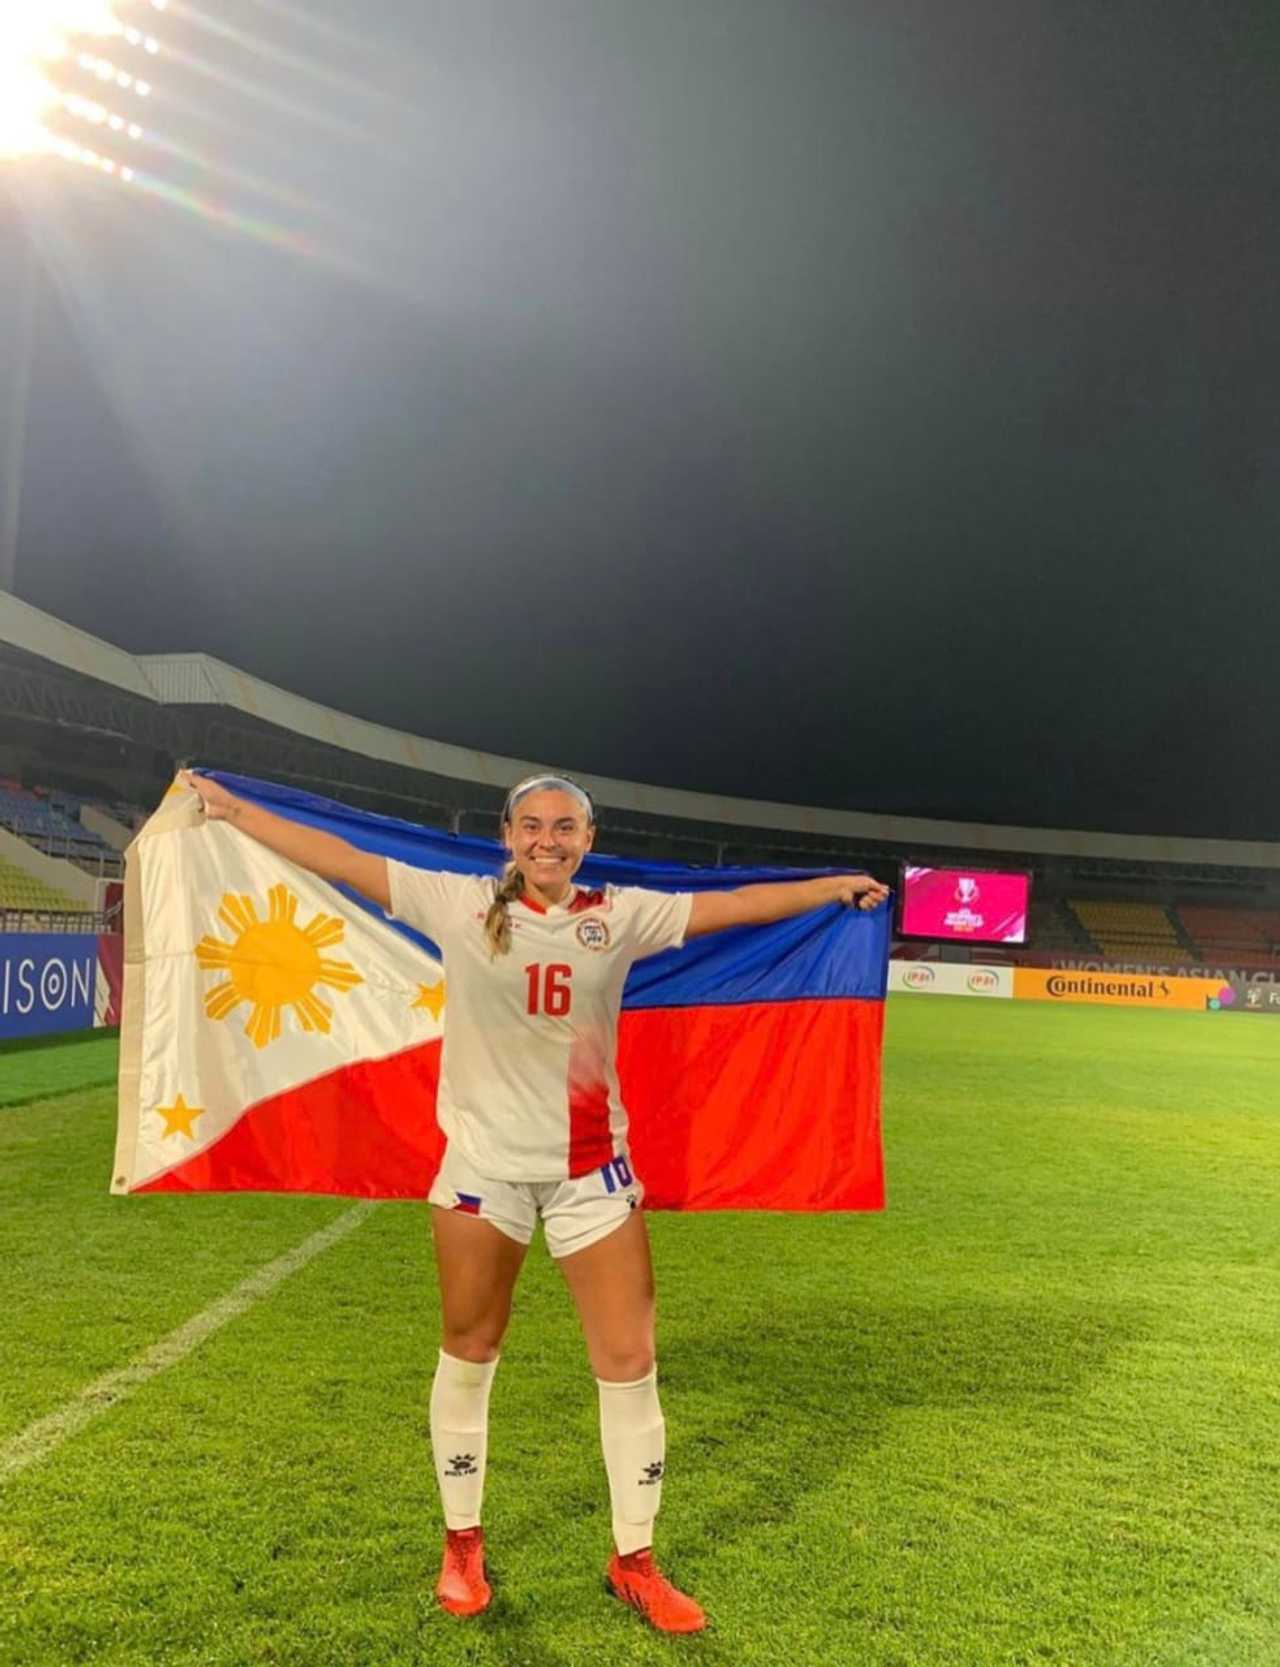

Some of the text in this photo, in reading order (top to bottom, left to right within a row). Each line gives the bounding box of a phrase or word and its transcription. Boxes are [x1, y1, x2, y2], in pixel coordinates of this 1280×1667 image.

[3, 957, 91, 1014] ISON
[525, 963, 573, 1017] 16
[1046, 975, 1153, 998] Continental
